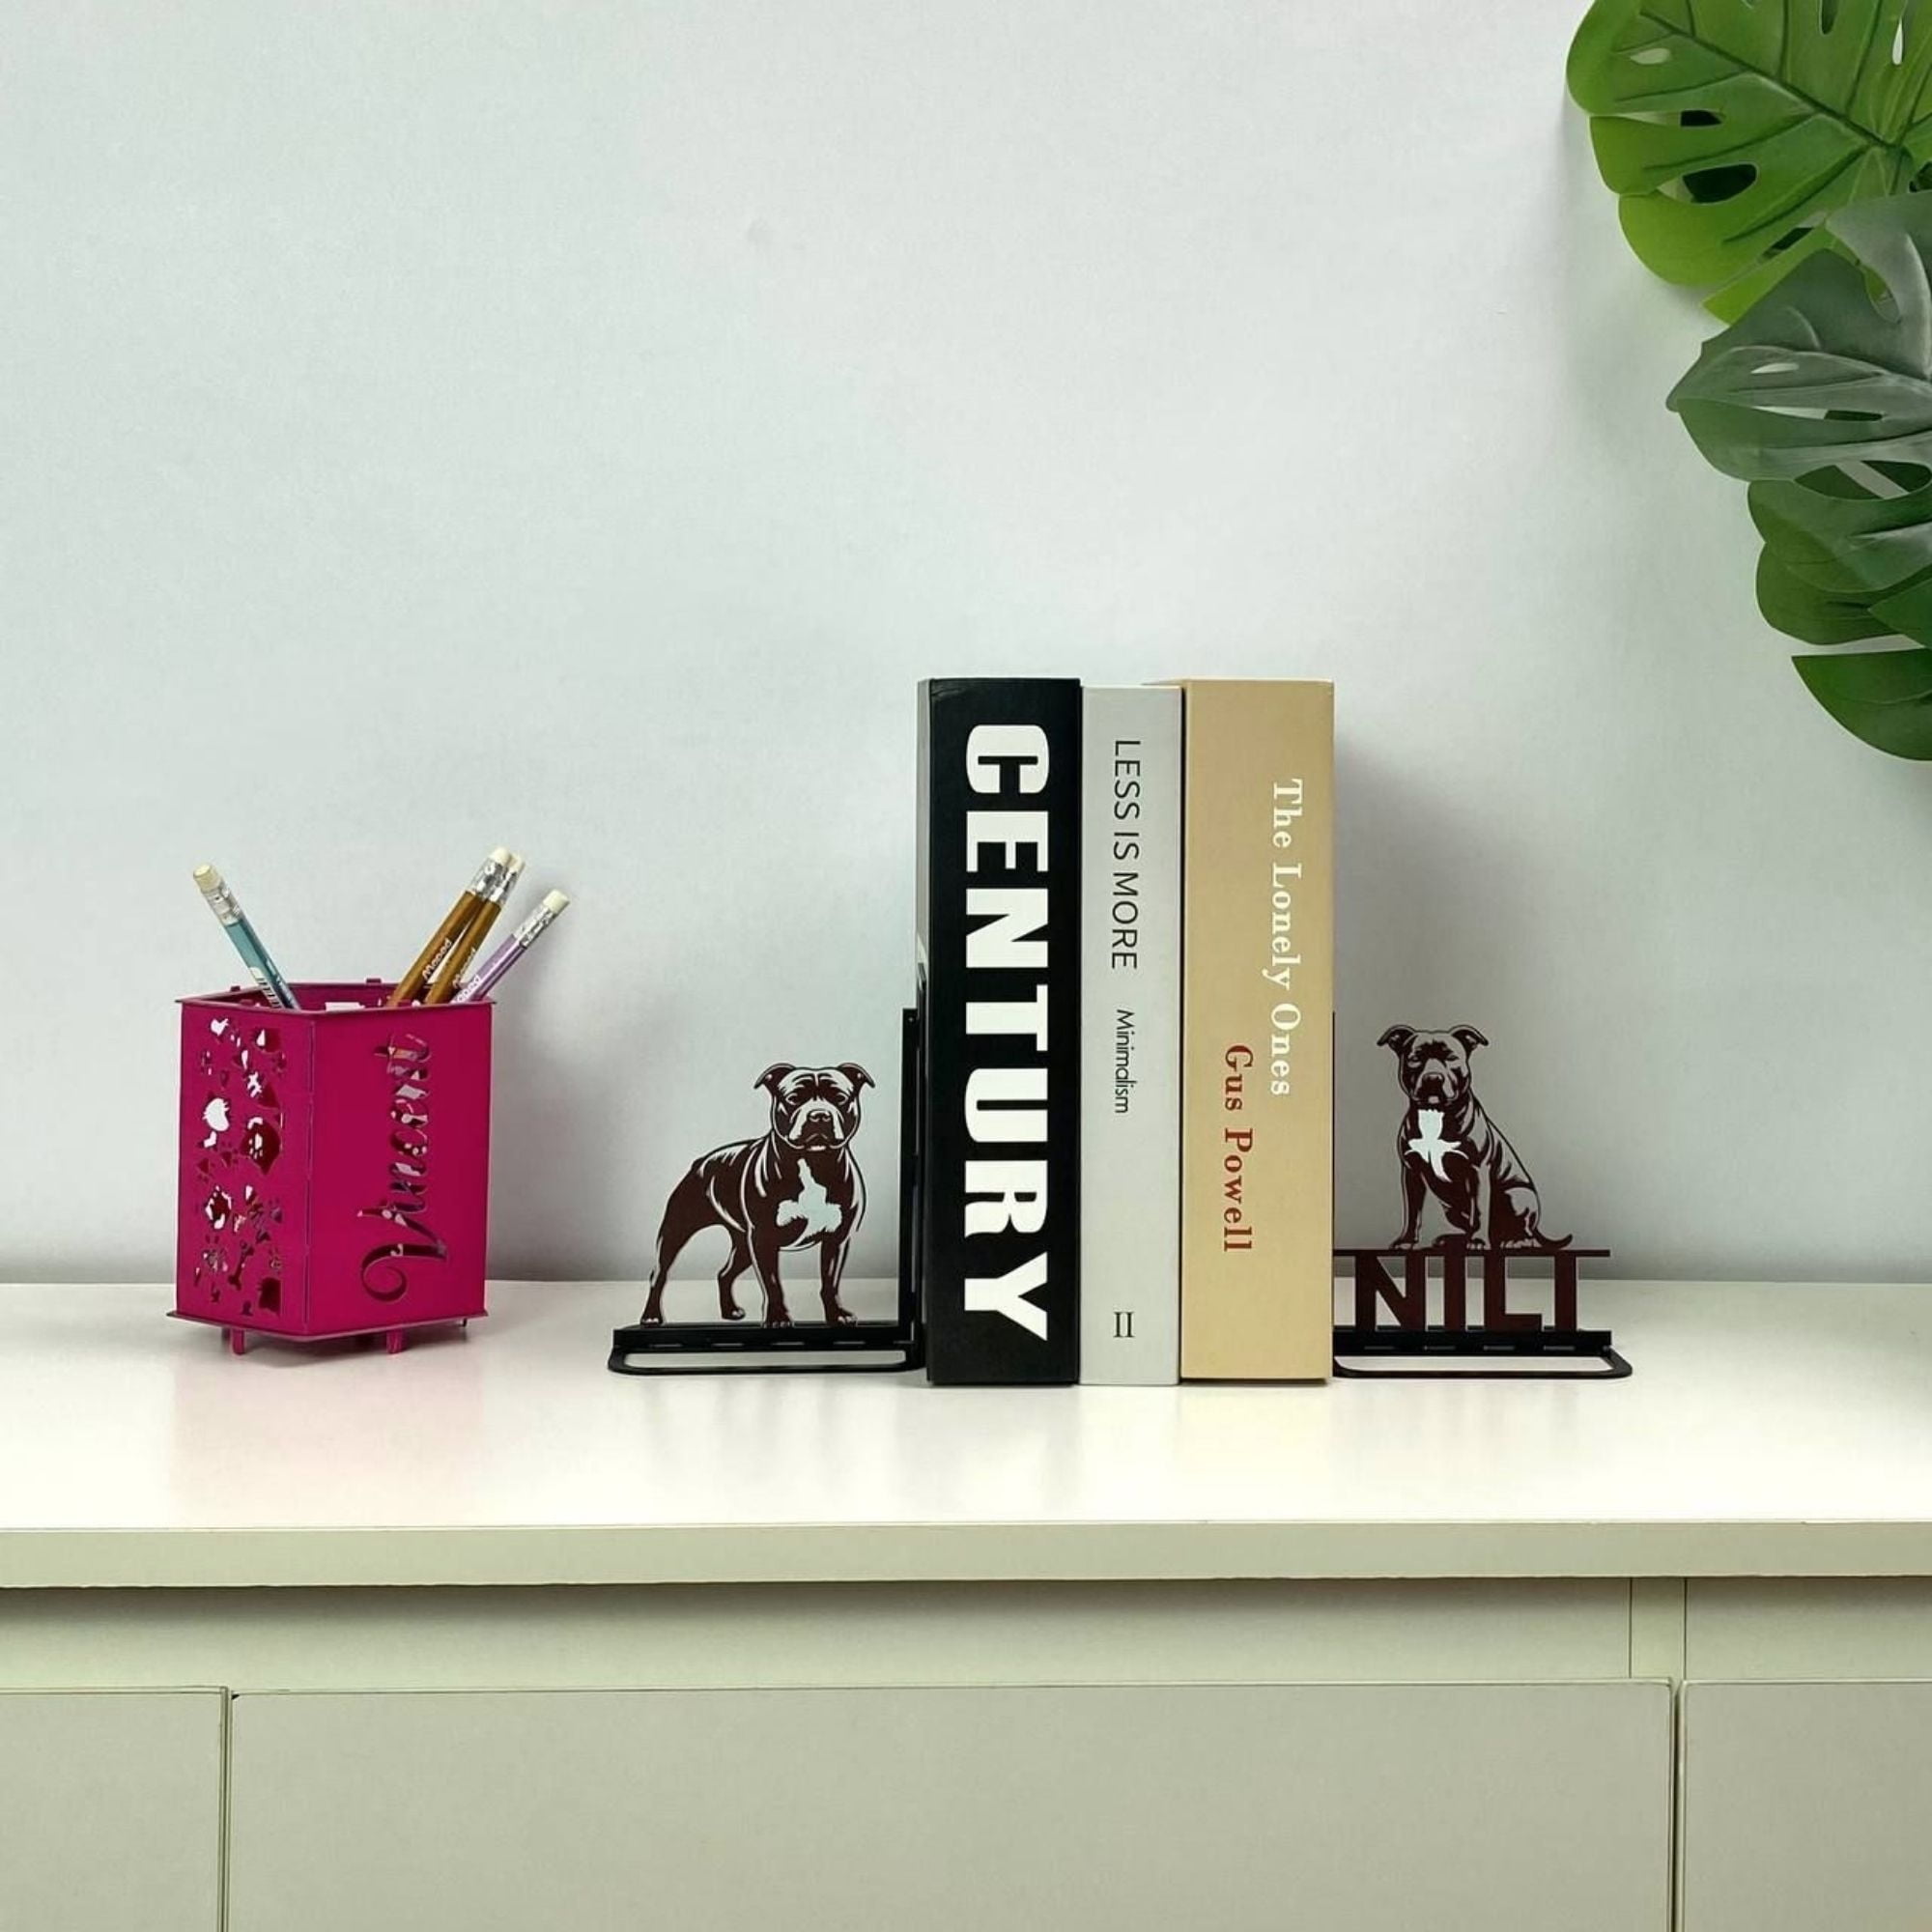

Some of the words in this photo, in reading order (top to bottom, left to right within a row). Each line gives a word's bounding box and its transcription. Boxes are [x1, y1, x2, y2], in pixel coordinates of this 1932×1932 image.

[1113, 740, 1141, 820] LESS
[1272, 779, 1302, 847] The
[1113, 832, 1140, 861] IS
[1111, 872, 1139, 970] MORE
[1262, 863, 1301, 990] Lonely
[964, 724, 1050, 1341] CENTURY
[1114, 1009, 1137, 1114] Minimalism
[1224, 1044, 1254, 1111] Gus
[1270, 1003, 1301, 1095] Ones
[357, 1033, 447, 1302] Vincent
[1223, 1127, 1254, 1252] Powell
[1114, 1311, 1134, 1338] II
